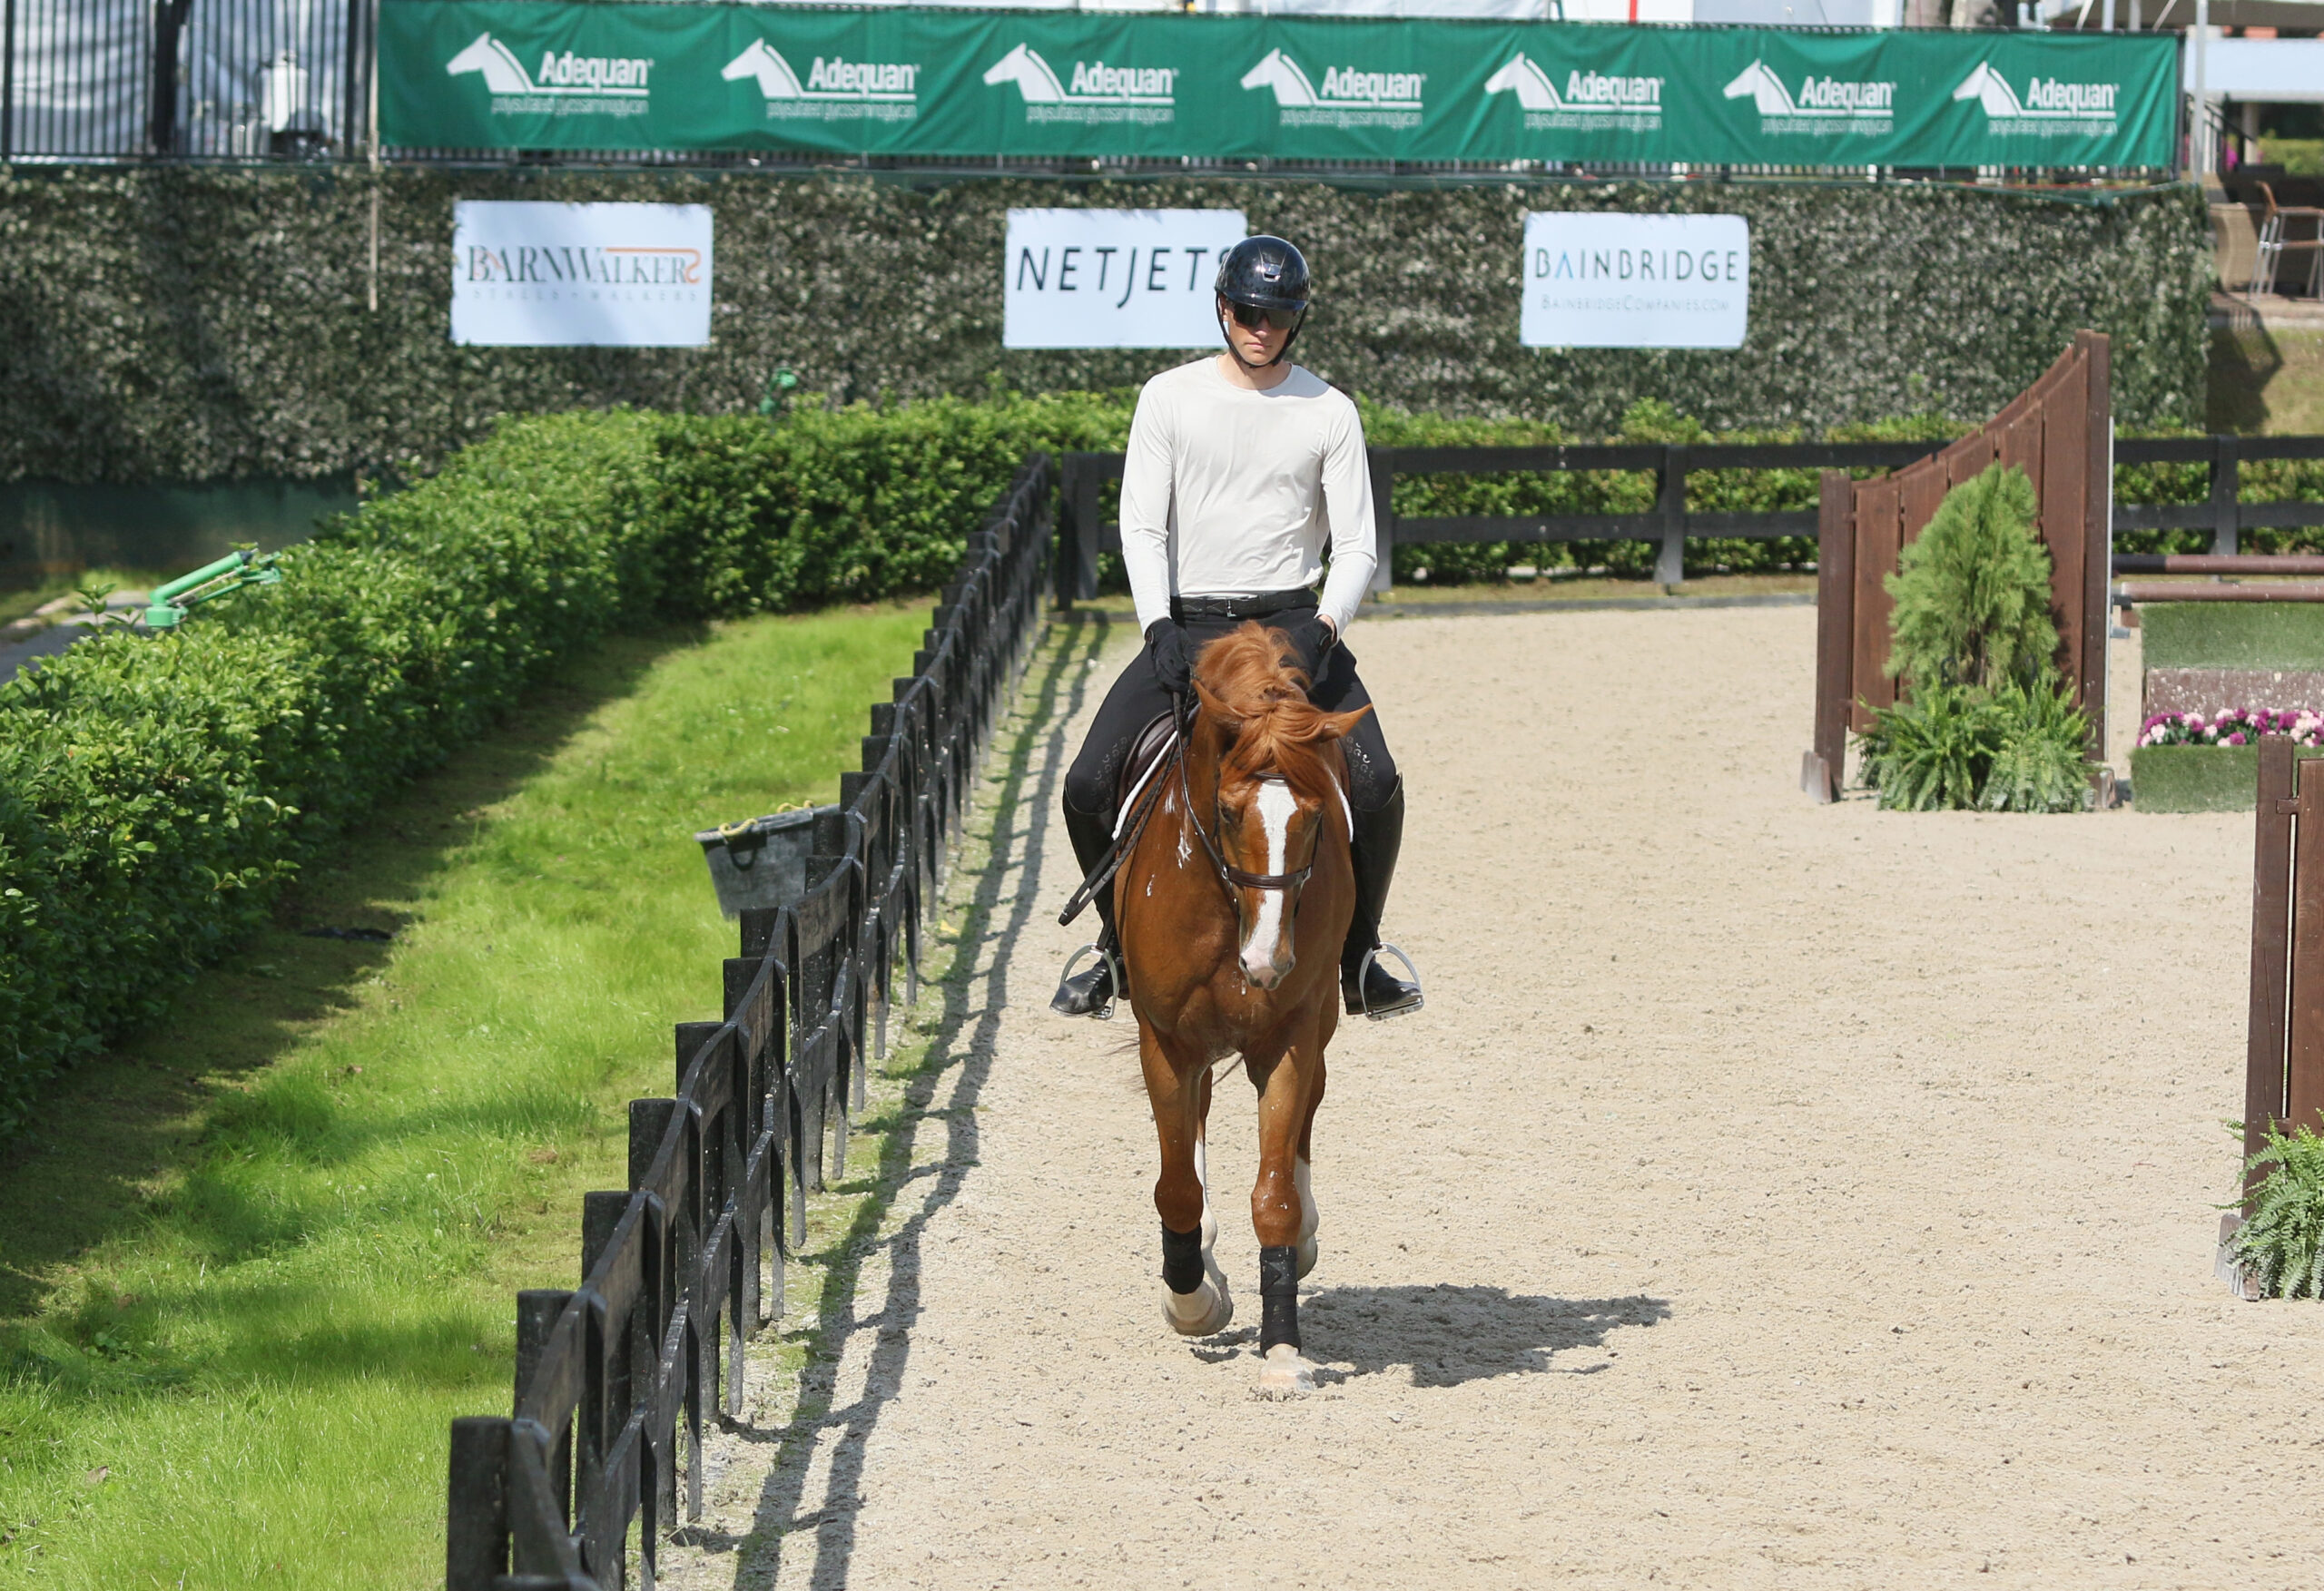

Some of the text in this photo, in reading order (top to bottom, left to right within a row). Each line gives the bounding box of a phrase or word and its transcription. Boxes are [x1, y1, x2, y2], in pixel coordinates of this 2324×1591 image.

[538, 51, 648, 93] Adequan
[807, 56, 915, 98] Adequan
[1069, 61, 1173, 102] Adequan
[1320, 66, 1422, 106] Adequan
[1565, 70, 1660, 110] Adequan
[1798, 75, 1892, 114] Adequan
[2026, 77, 2115, 116] Adequan
[1017, 247, 1230, 309] NETJET
[1536, 248, 1738, 281] BAINBRIDGE
